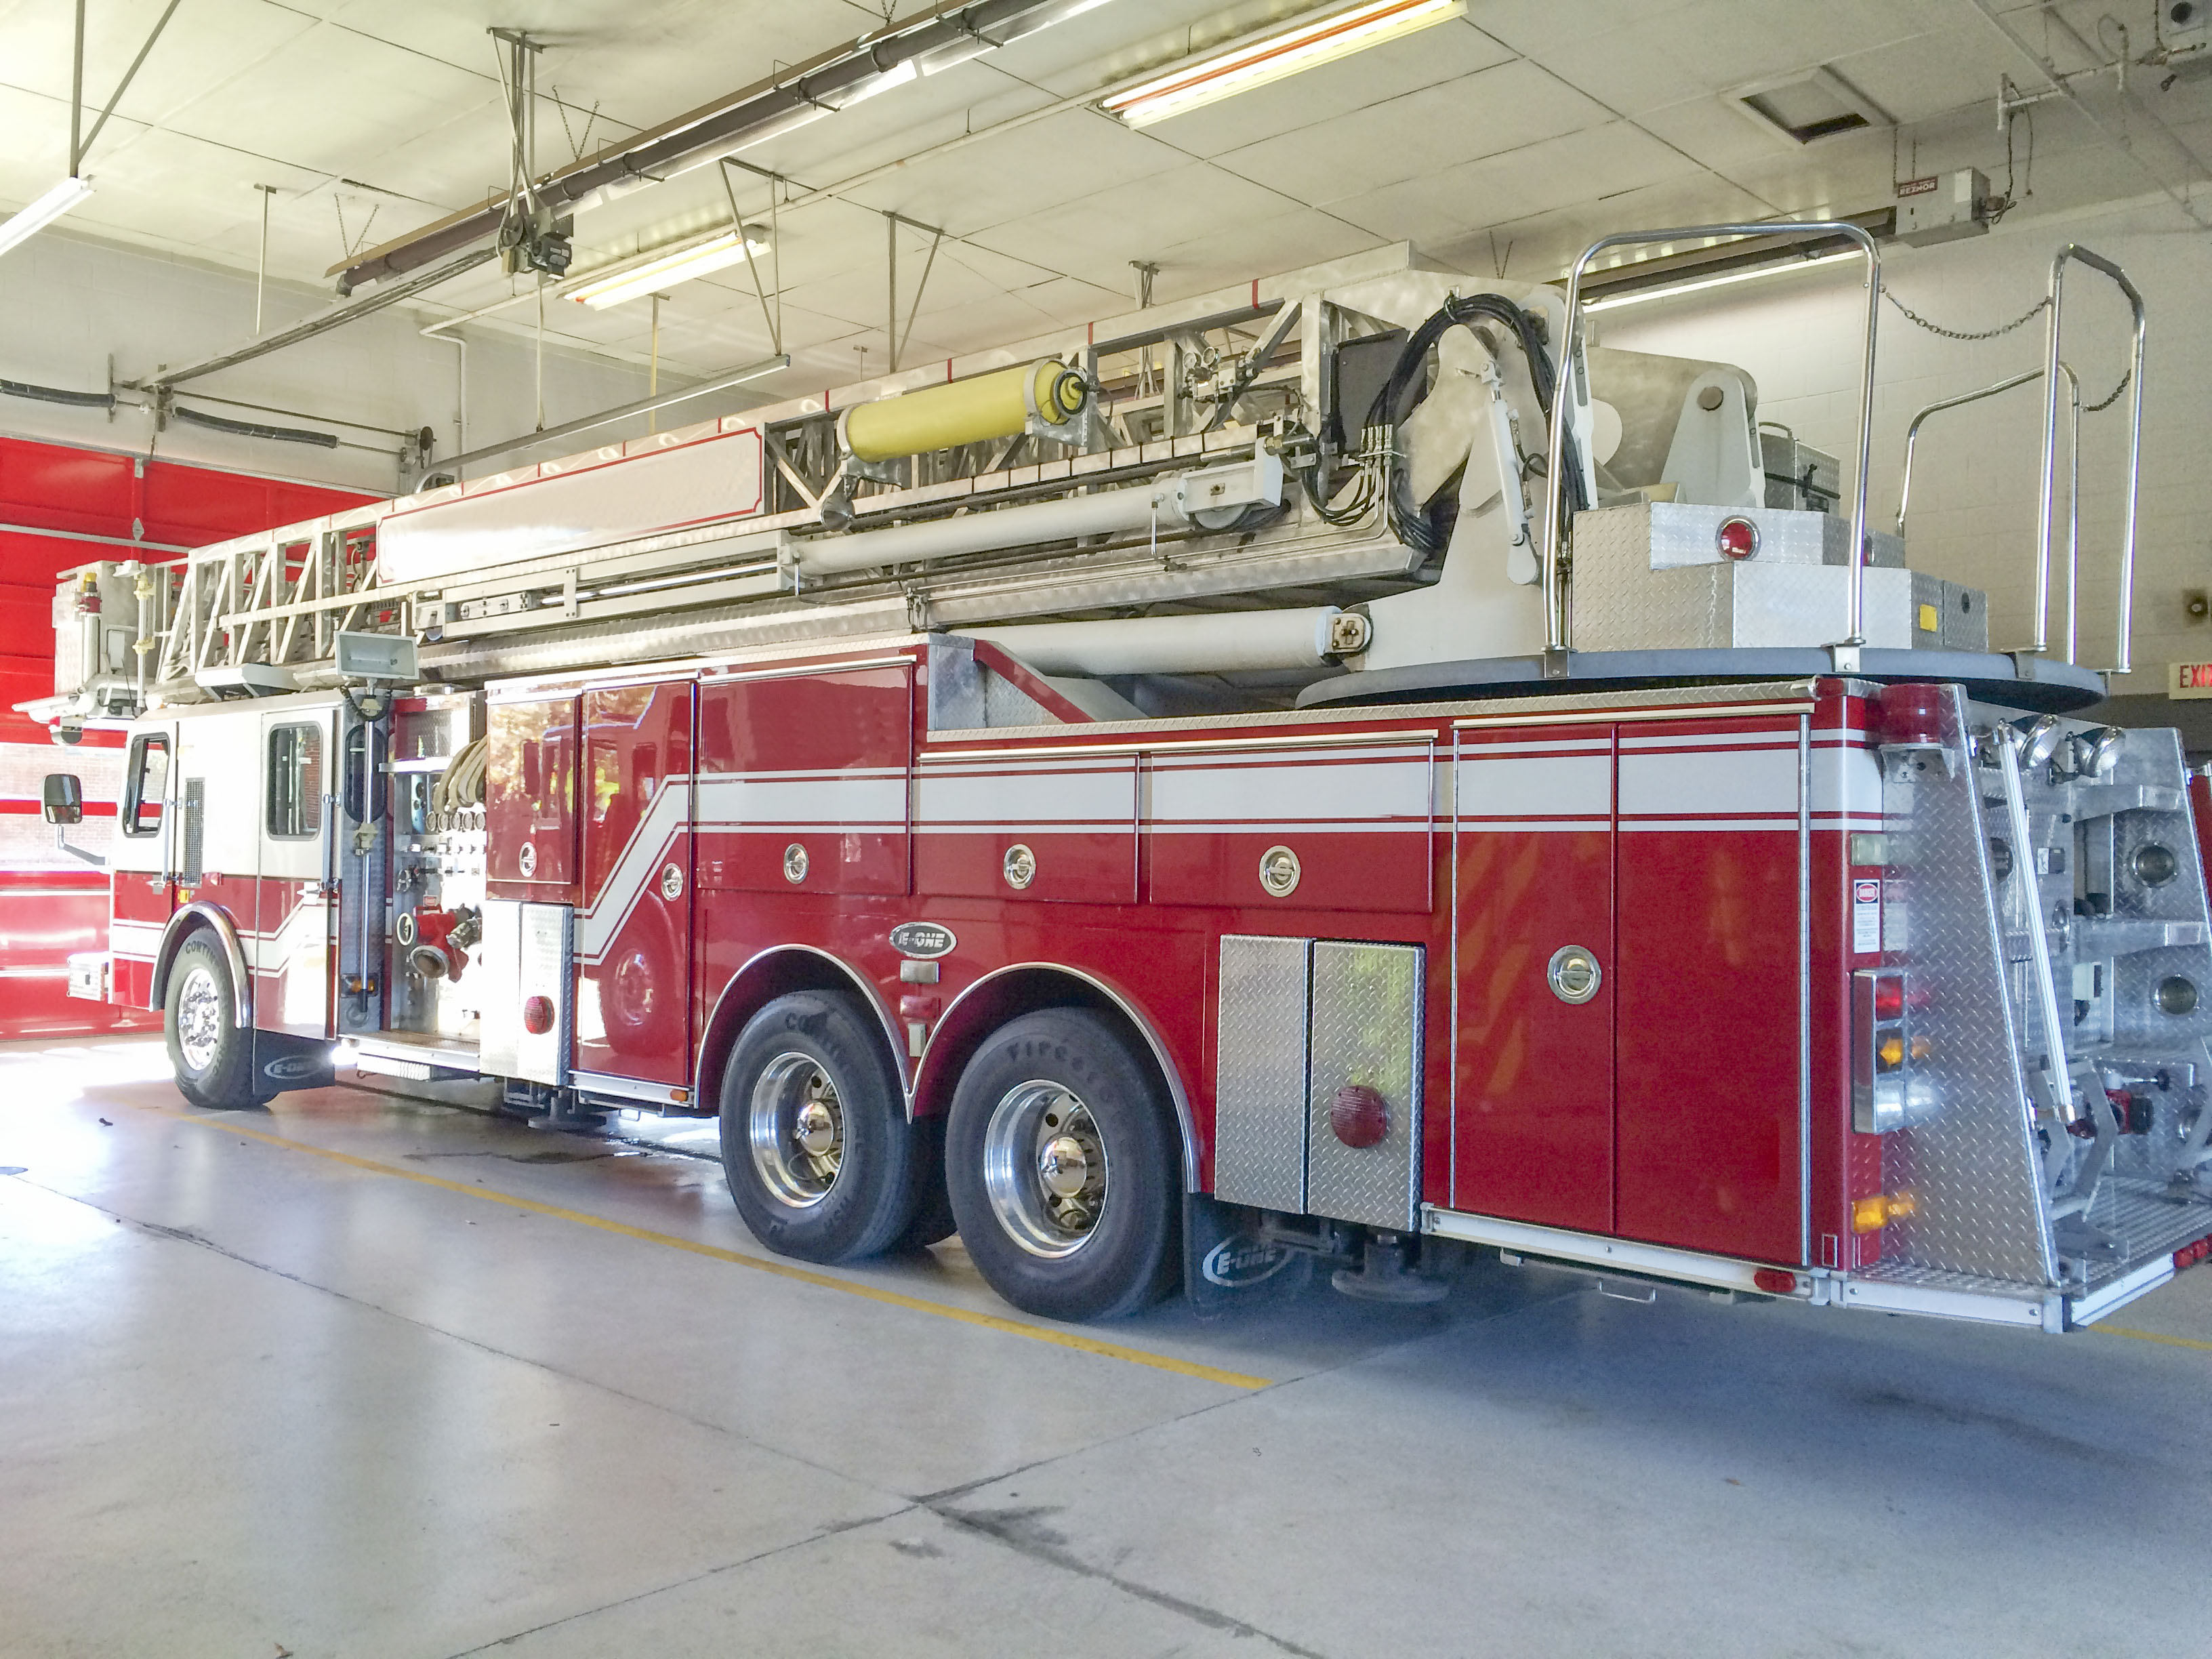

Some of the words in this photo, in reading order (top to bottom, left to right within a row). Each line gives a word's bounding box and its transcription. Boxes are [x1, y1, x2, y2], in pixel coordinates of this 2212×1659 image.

[1900, 182, 1936, 195] REZNOR
[898, 931, 945, 948] E-ONE
[1216, 1246, 1277, 1275] E-ONE
